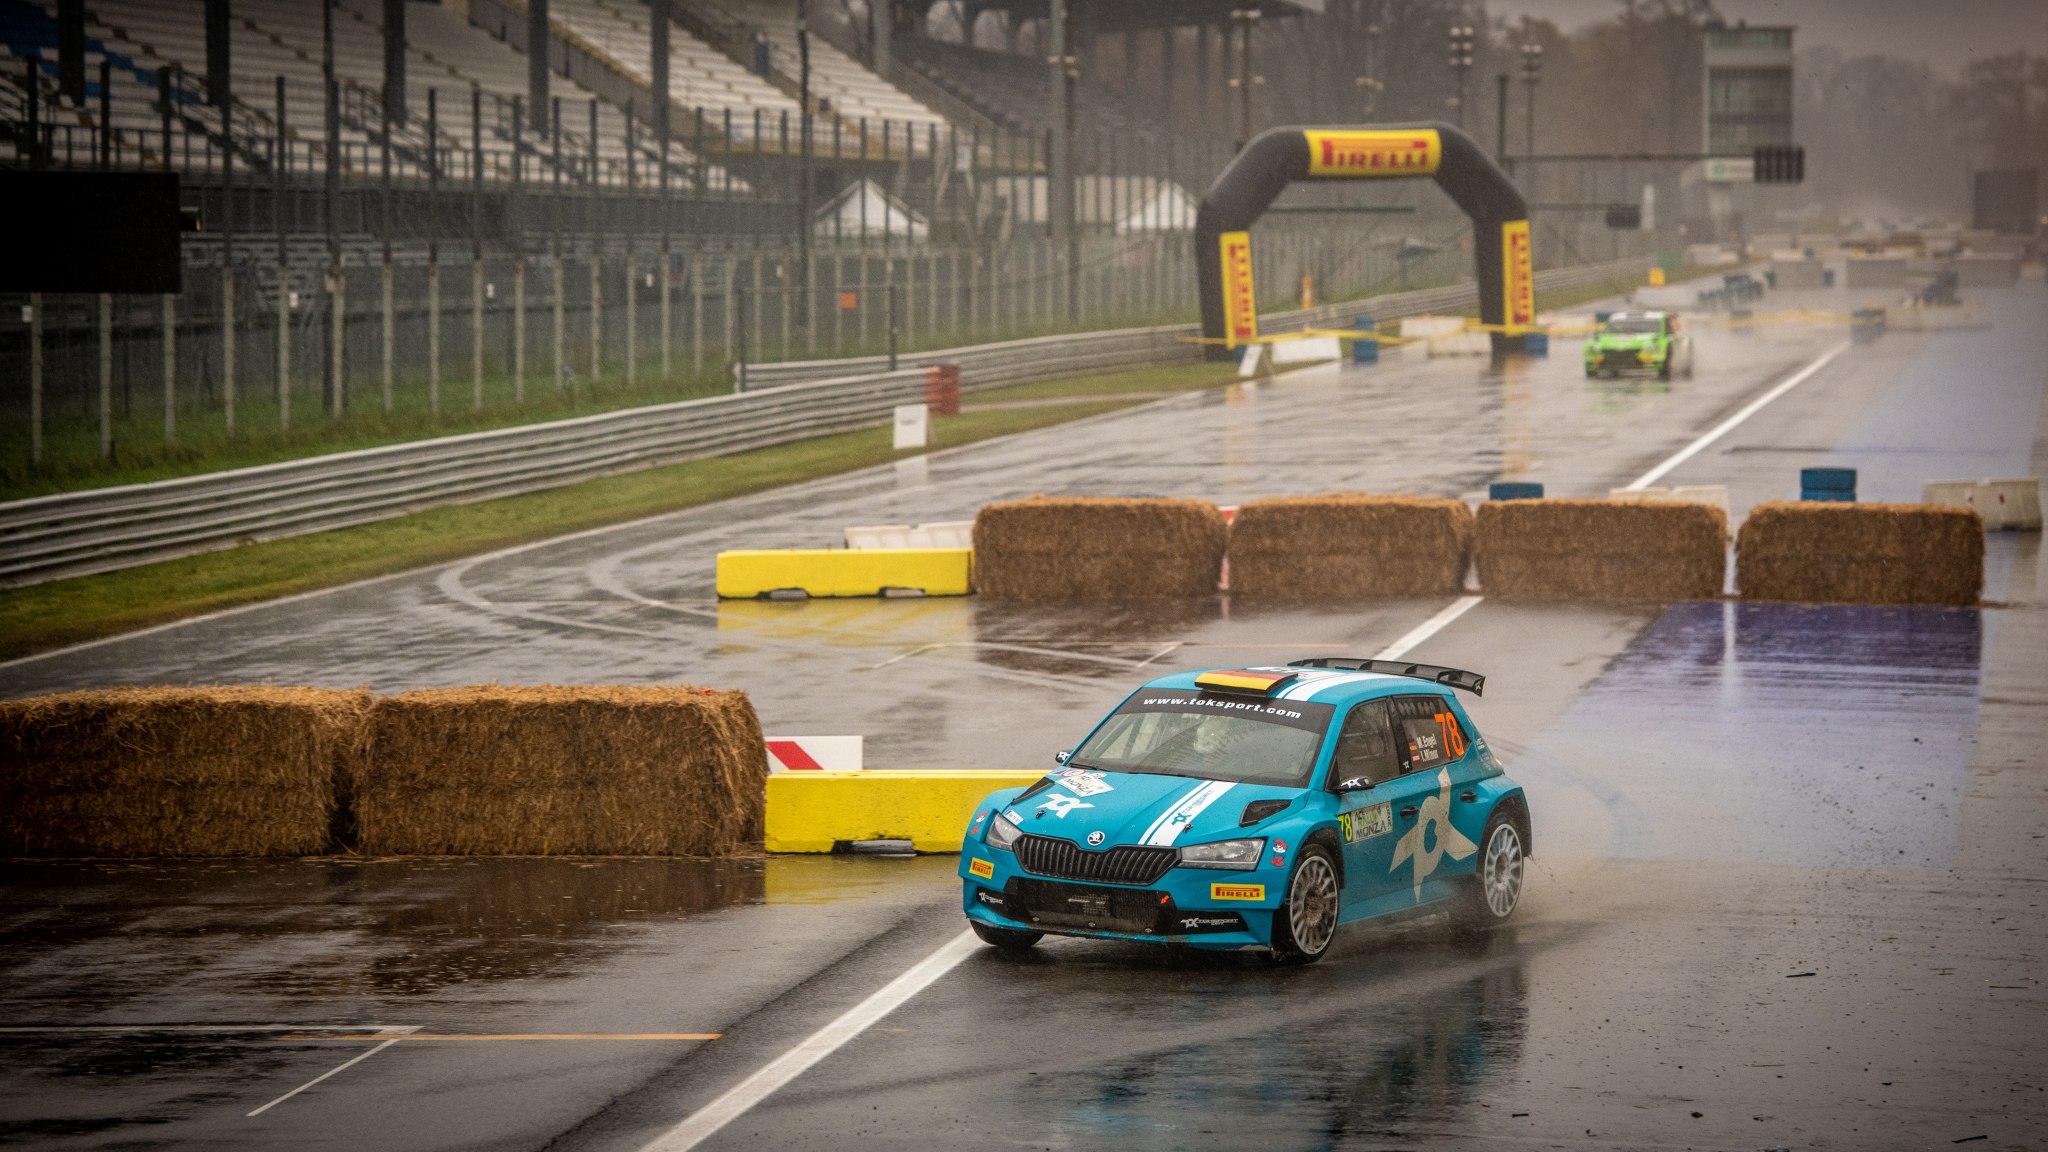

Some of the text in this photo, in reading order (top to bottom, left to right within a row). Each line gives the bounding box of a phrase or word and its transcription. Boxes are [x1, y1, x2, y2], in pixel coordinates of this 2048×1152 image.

[1321, 139, 1429, 167] PIRELLI
[1228, 243, 1253, 338] PIRELLI
[1510, 231, 1530, 326] PIRELLI
[1143, 698, 1302, 719] www.toksport.com
[1434, 711, 1465, 758] 78
[1337, 813, 1353, 842] 78
[1356, 820, 1387, 839] MONZA
[1215, 886, 1261, 898] PIRELLI
